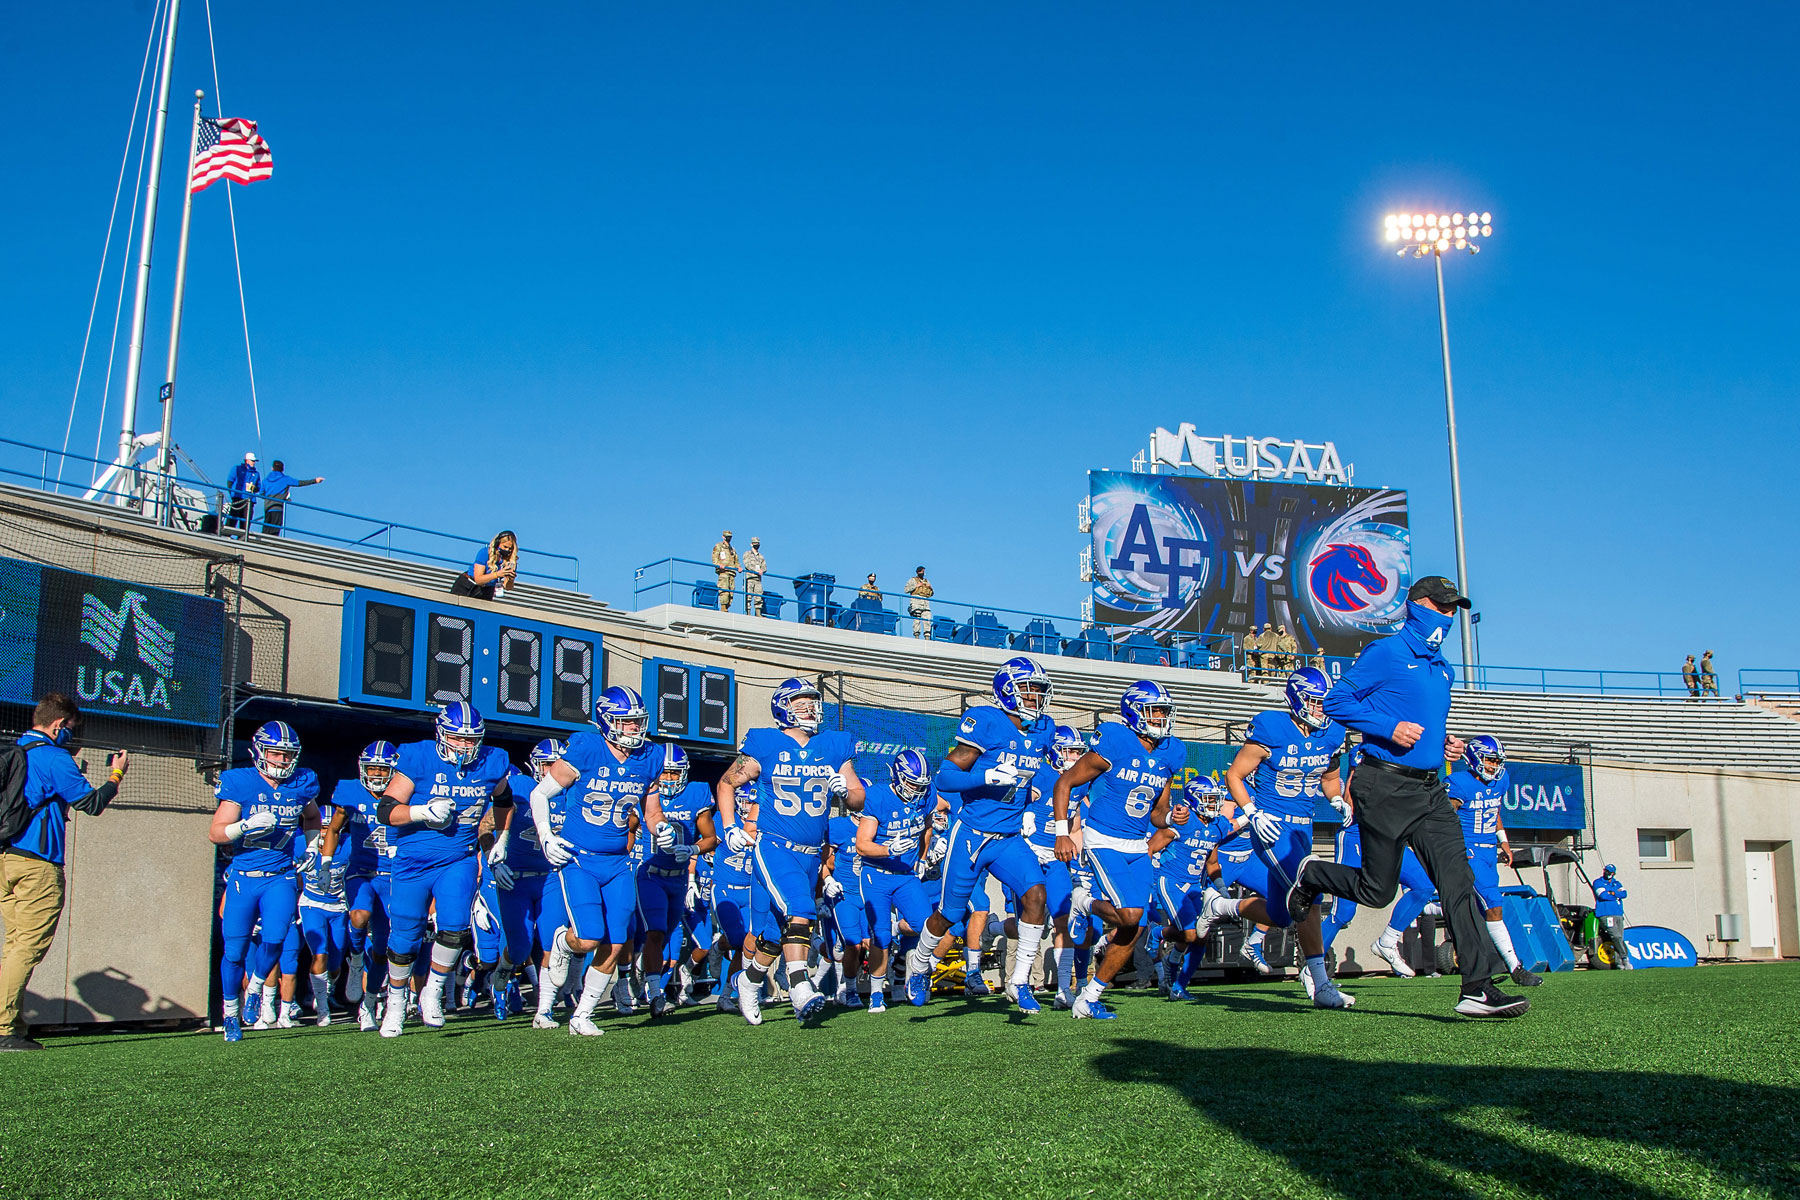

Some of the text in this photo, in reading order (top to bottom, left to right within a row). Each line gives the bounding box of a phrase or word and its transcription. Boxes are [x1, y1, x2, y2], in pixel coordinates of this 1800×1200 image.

[1223, 434, 1347, 482] USAA
[1110, 503, 1211, 610] AF
[77, 665, 171, 710] USAA
[659, 665, 728, 734] 25
[772, 763, 831, 777] AIR FORCE
[1018, 755, 1042, 769] FORC
[1278, 754, 1330, 768] AIR FORCE
[586, 778, 645, 795] AIR FORCE
[1116, 767, 1139, 783] AIR
[430, 784, 487, 798] AIR FORCE
[771, 776, 829, 817] 53
[1124, 785, 1156, 818] 6
[1503, 783, 1567, 812] USAA
[1473, 807, 1499, 834] 12
[1638, 942, 1688, 960] USAA
